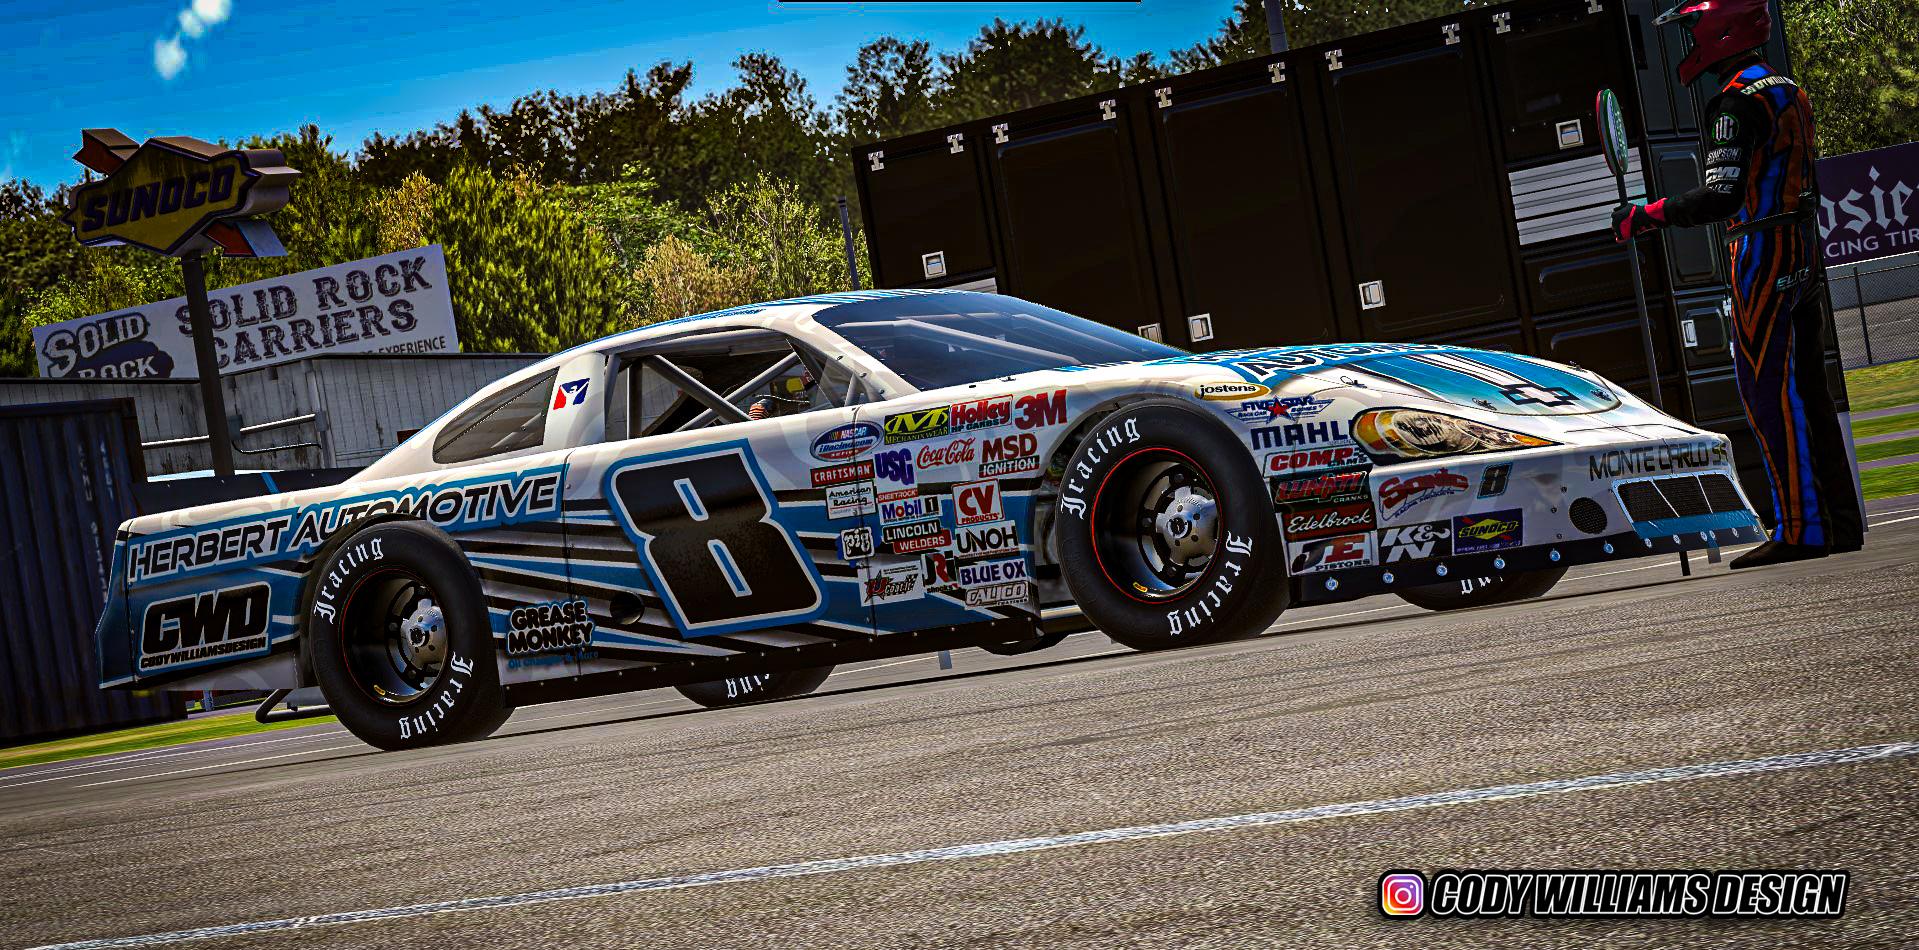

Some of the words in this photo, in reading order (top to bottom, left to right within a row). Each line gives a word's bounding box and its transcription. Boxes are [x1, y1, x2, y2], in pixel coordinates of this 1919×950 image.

[82, 165, 236, 233] SUNOCO
[175, 283, 300, 337] SOLID
[311, 256, 433, 313] ROCK
[43, 313, 148, 378] SOLID
[213, 299, 419, 370] CARRIERS
[1199, 384, 1257, 399] jostens
[950, 399, 1011, 427] Holley
[1014, 388, 1068, 430] 3M
[840, 426, 871, 439] NASCAR
[966, 419, 1000, 430] CARBS
[1250, 419, 1354, 451] MAHL
[819, 438, 875, 453] iRacing.com
[981, 432, 1038, 463] MSD
[1270, 447, 1354, 472] COMP
[814, 464, 871, 483] CRAFTSMAN
[874, 448, 915, 486] USG
[983, 457, 1036, 477] IGNITION
[1589, 448, 1656, 482] MONTE
[1658, 440, 1710, 471] CARLO
[1712, 442, 1728, 466] SS
[828, 485, 872, 498] American
[1278, 472, 1362, 500] LUNATI
[1478, 462, 1512, 499] 8
[833, 495, 868, 507] Racing
[881, 498, 923, 520] Mobil
[958, 484, 995, 516] CV
[1333, 494, 1369, 503] CRANKS
[886, 521, 938, 541] LINCOLN
[961, 512, 999, 524] PRODUCTS
[1287, 508, 1373, 534] Edelbrock
[1459, 520, 1518, 537] SUNOCO
[129, 517, 291, 579] HERBERT
[610, 447, 823, 631] 8
[900, 535, 945, 551] WELDERS
[956, 525, 1019, 554] UNOH
[1291, 534, 1366, 573] JE
[1315, 559, 1371, 572] PISTONS
[960, 564, 1001, 586] BLUE
[1002, 560, 1027, 580] OX
[965, 580, 1028, 606] CALICO
[143, 582, 271, 655] CWD
[510, 600, 588, 631] GREASE
[508, 621, 595, 655] MONKEY
[140, 636, 267, 669] CODYWILLIAMSDESIGN
